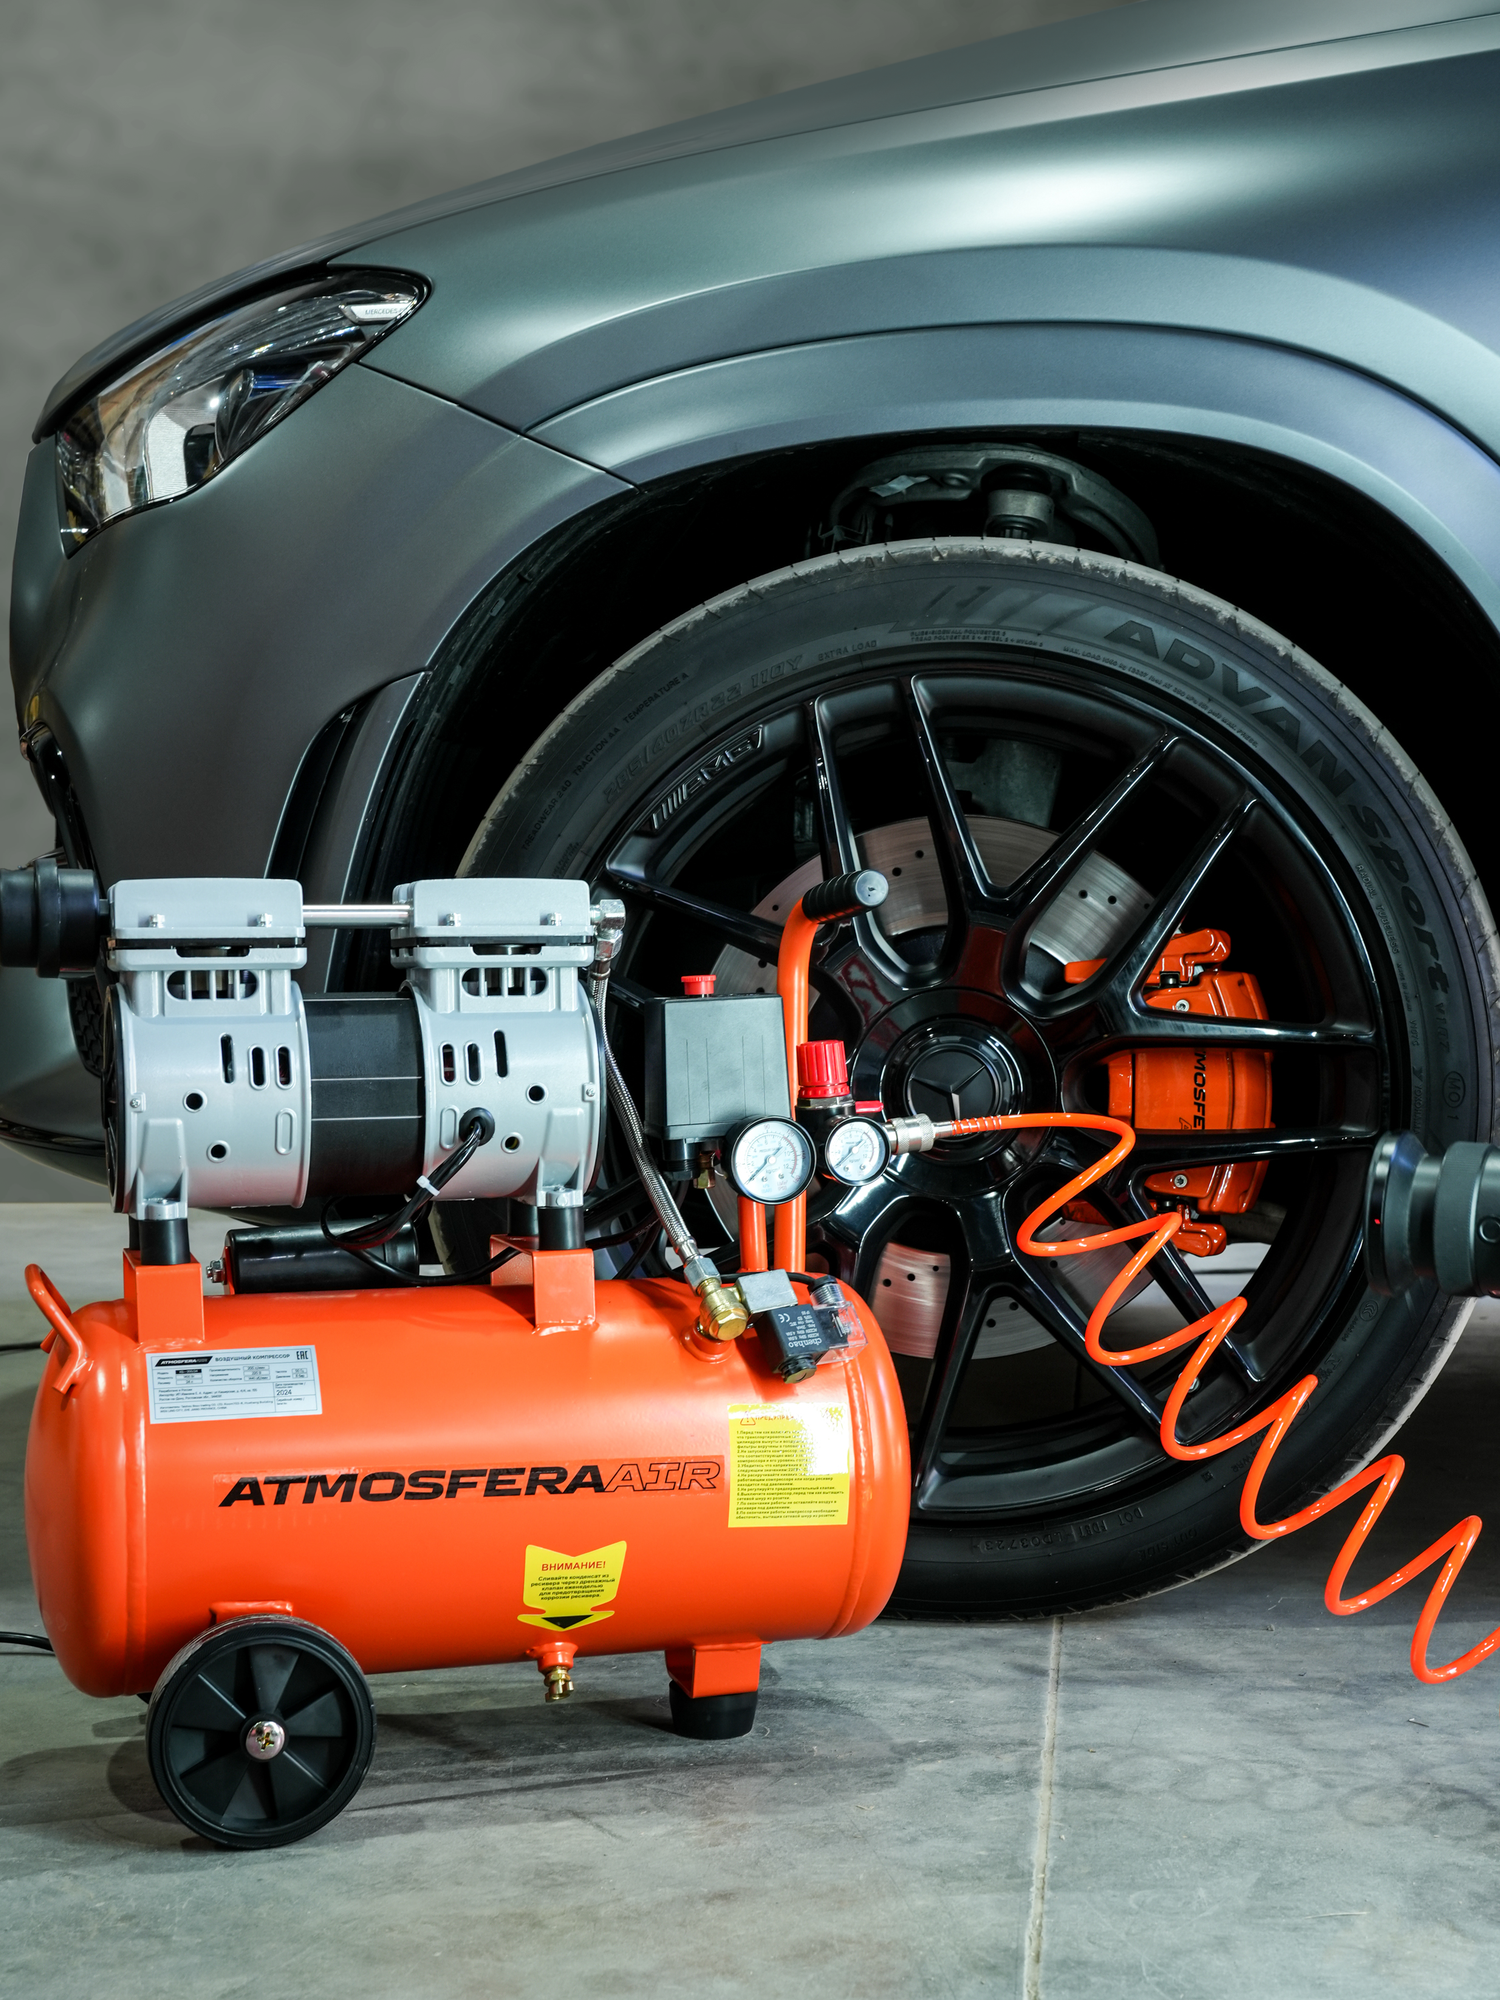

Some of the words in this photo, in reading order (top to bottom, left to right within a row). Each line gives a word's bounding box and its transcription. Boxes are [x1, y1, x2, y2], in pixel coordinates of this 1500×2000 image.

[850, 638, 879, 653] LOAD
[520, 795, 560, 853] TREADWEAR
[571, 736, 610, 778] TRACTION
[621, 674, 682, 726] TEMPERATURE
[1103, 620, 1357, 798] ADVAN
[1350, 804, 1449, 993] Sport
[1355, 862, 1379, 900] RADIAL
[1375, 903, 1401, 955] TUBELESS
[1193, 1051, 1206, 1130] MOSFE
[296, 1351, 309, 1360] EAC
[1116, 1506, 1145, 1527] DOT
[541, 1561, 606, 1571] ВНИМАНИЕ!
